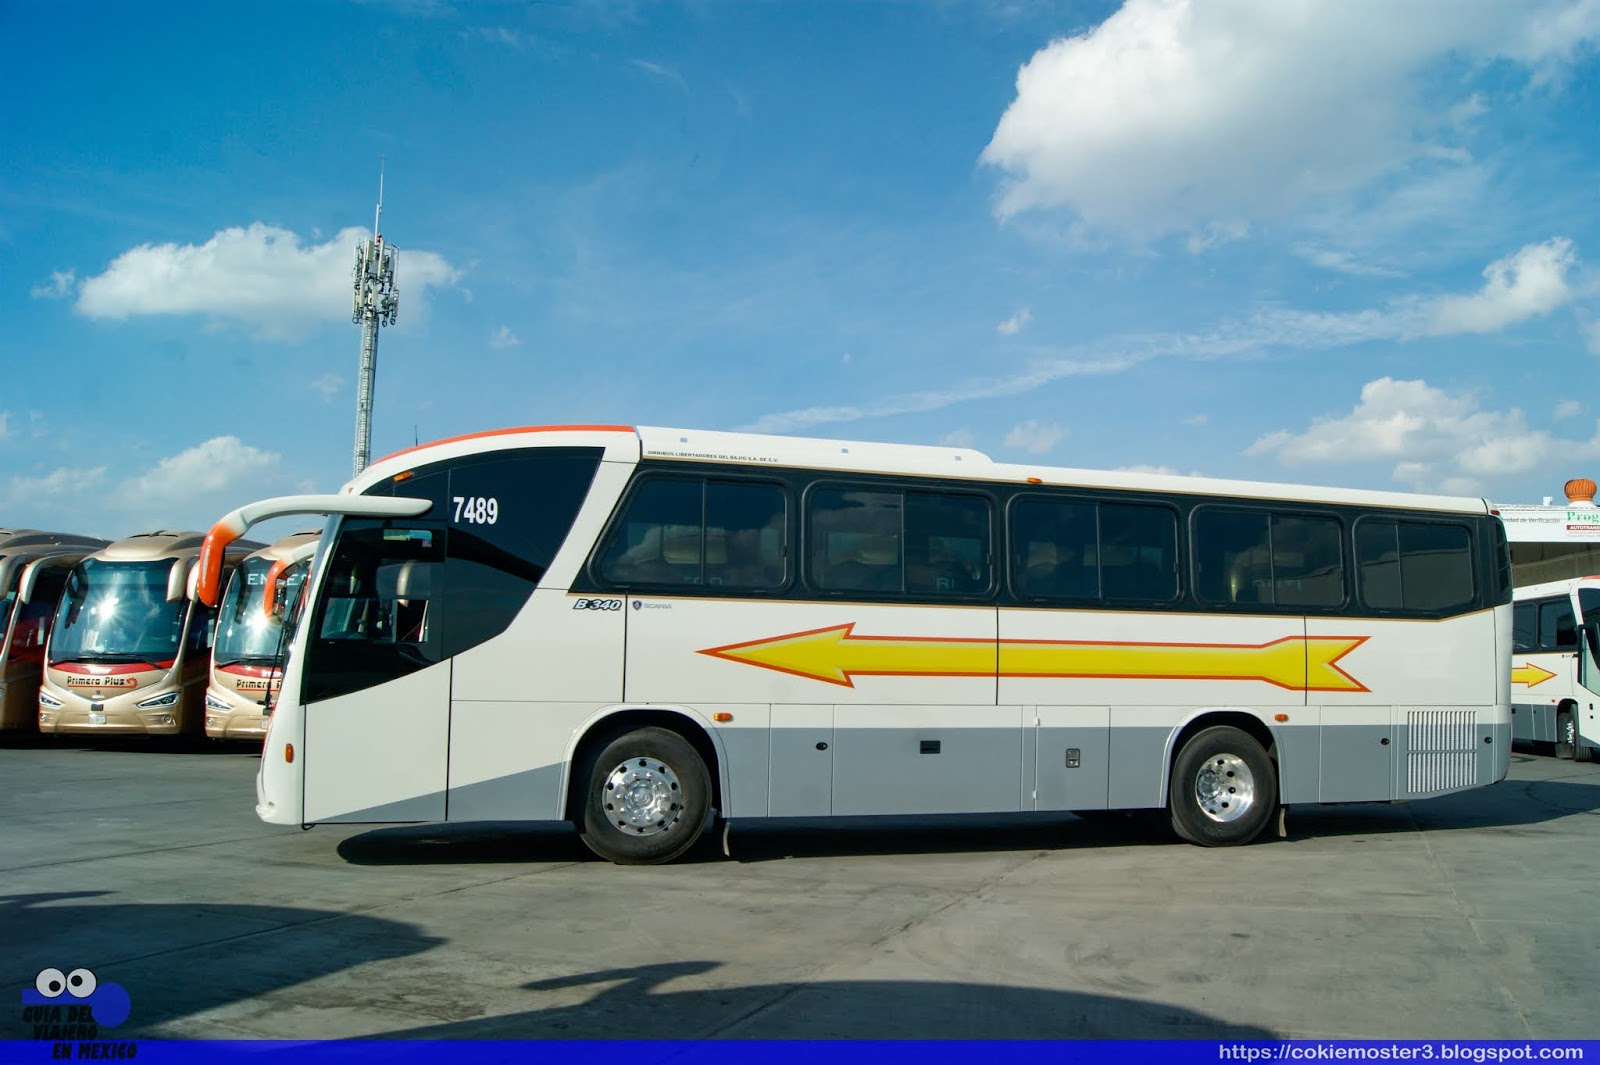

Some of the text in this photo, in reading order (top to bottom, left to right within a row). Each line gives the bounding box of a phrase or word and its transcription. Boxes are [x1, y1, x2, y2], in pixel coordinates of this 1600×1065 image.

[453, 496, 498, 525] 7489
[66, 676, 125, 686] Primera Plus
